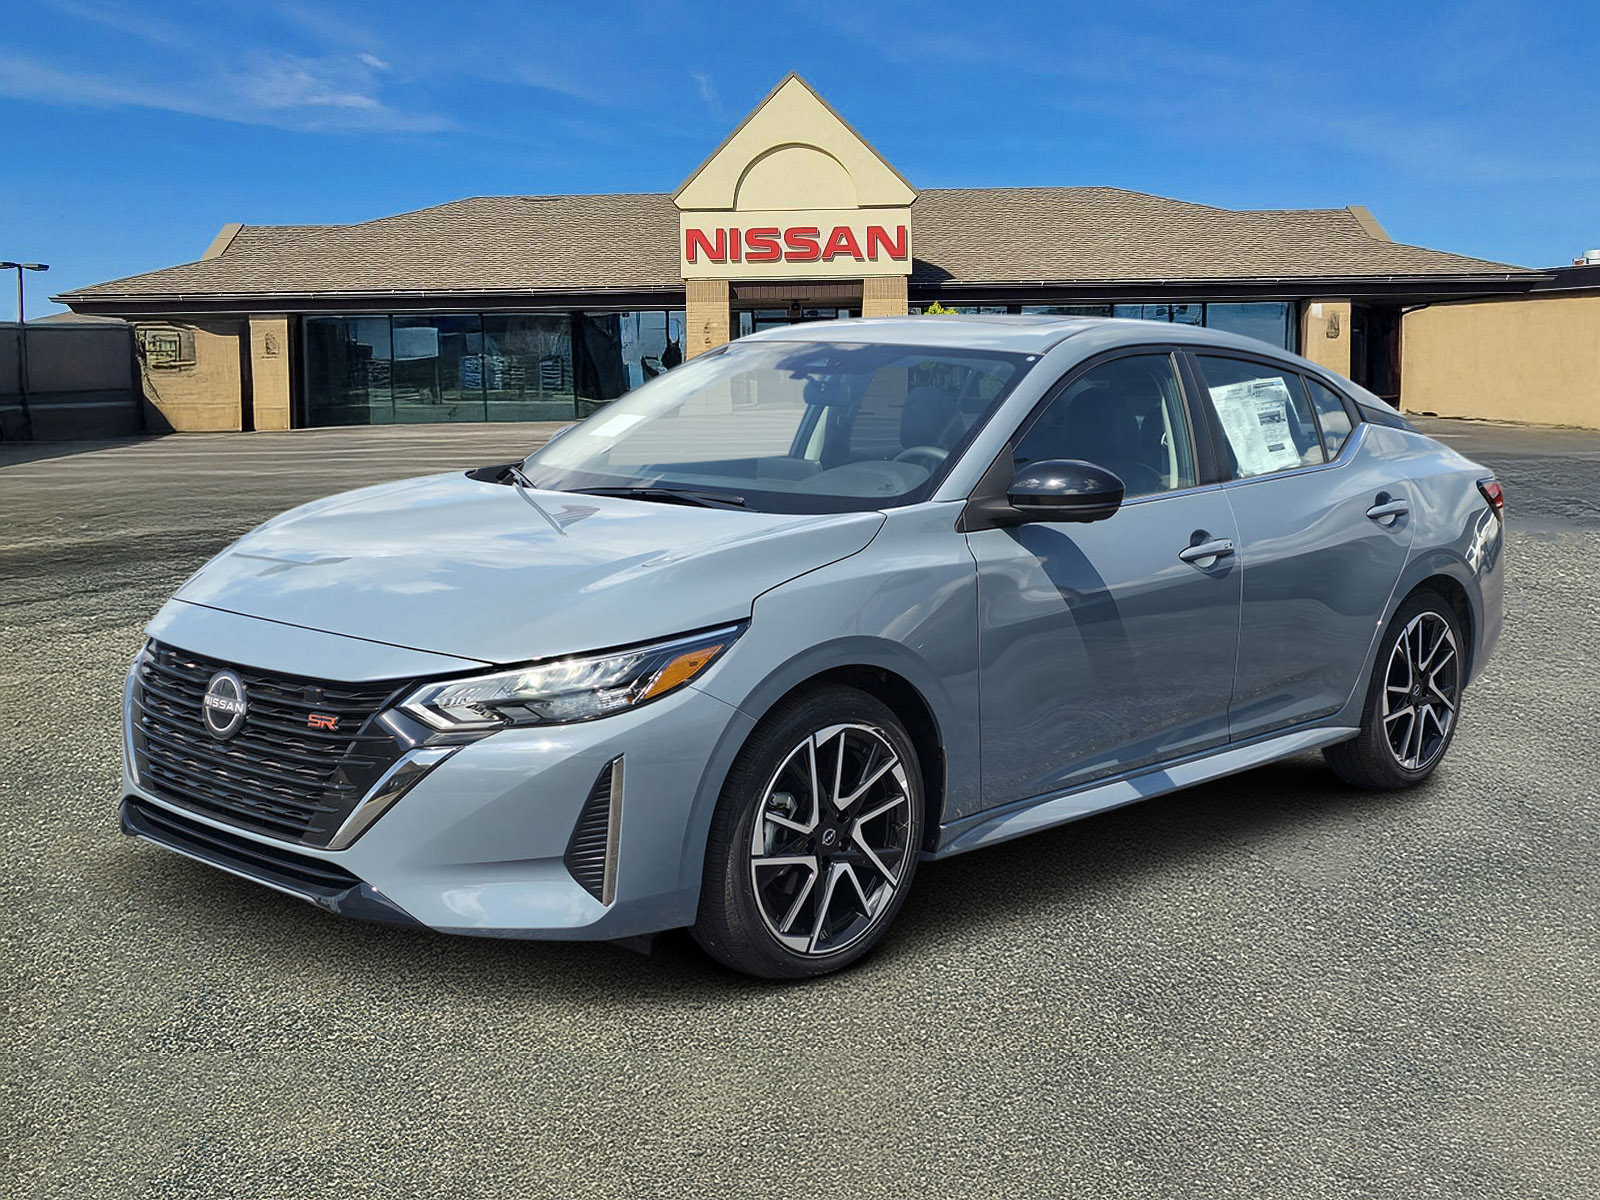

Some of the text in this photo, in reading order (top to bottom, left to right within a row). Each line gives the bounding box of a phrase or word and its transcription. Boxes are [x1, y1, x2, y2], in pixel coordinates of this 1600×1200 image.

[685, 225, 907, 263] NISSAN
[204, 694, 245, 714] NISSAN
[307, 713, 339, 730] SR
